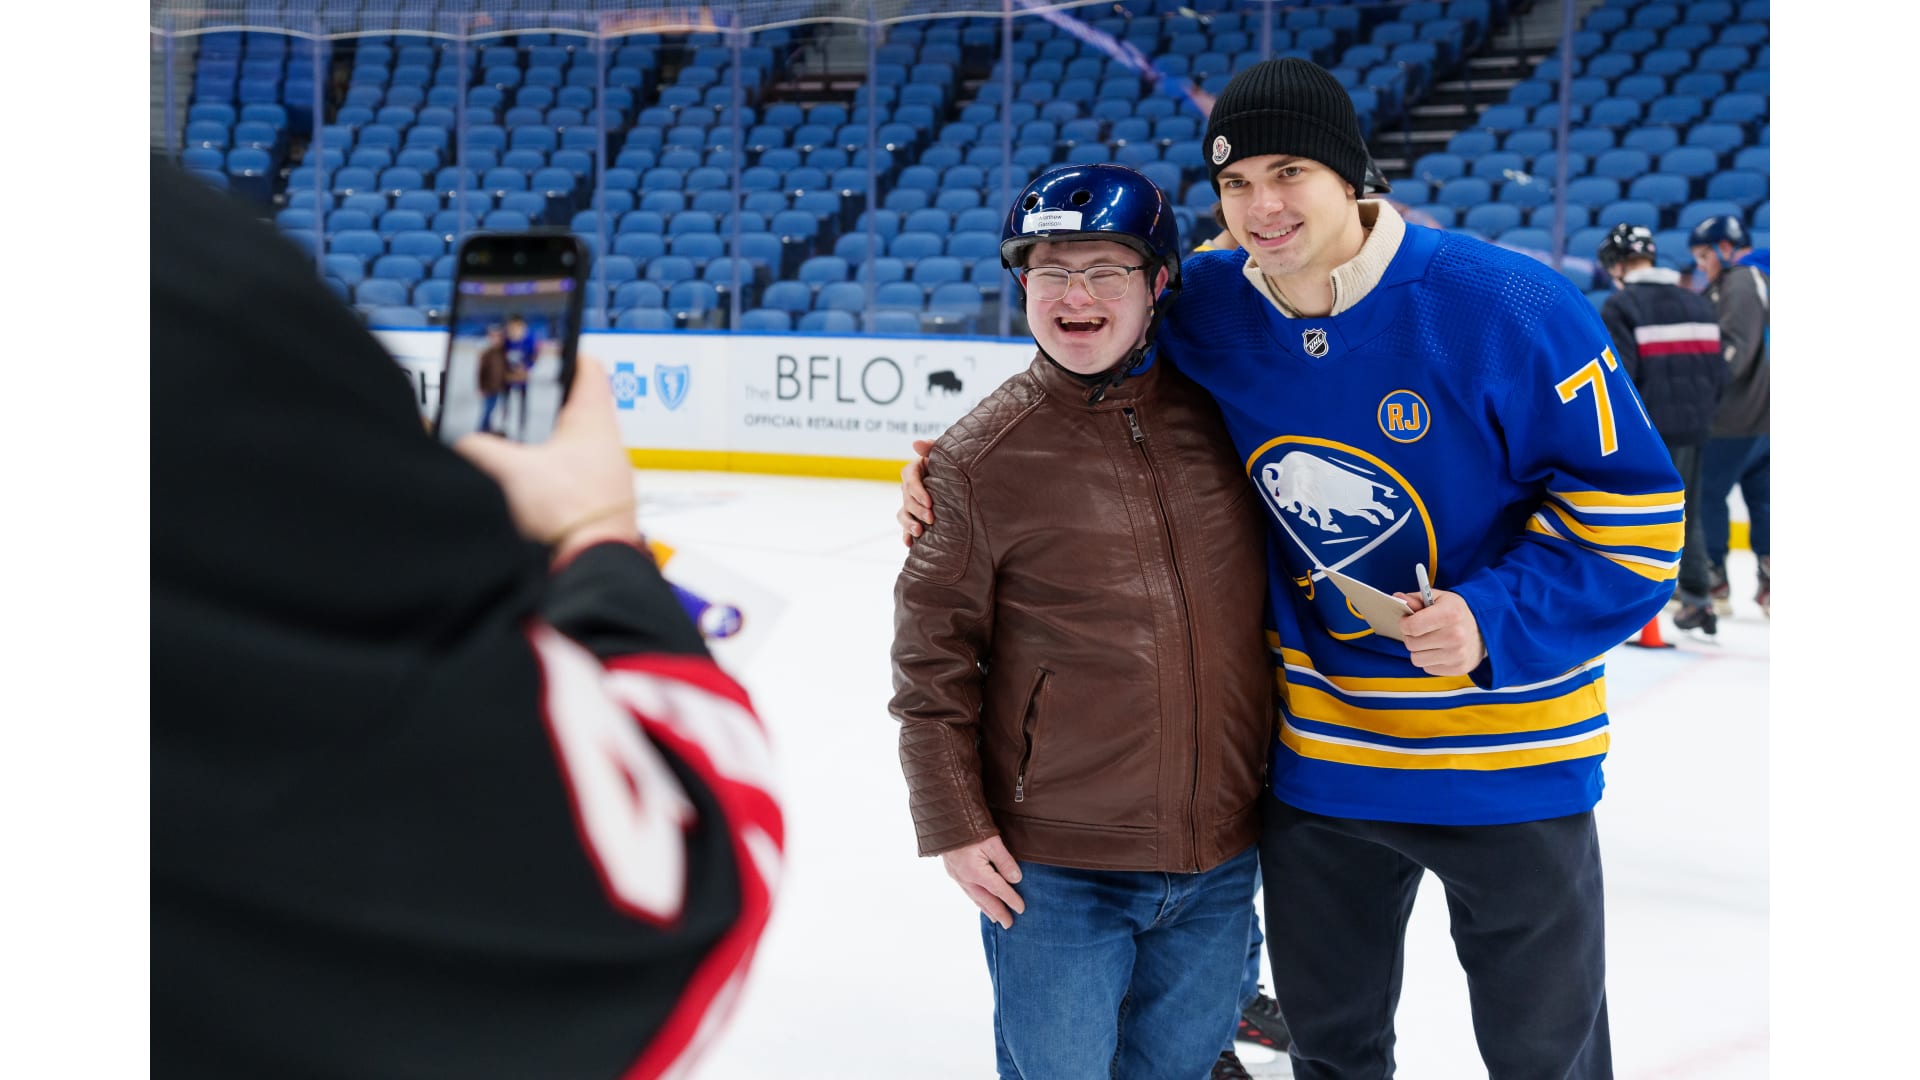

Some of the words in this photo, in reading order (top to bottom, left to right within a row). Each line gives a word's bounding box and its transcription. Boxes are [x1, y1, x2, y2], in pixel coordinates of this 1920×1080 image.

[1308, 335, 1322, 352] NHL
[744, 384, 770, 401] The
[776, 355, 904, 405] BFLO
[1554, 344, 1652, 457] 7
[744, 413, 801, 428] OFFICIAL
[807, 416, 860, 431] RETAILER
[864, 418, 883, 432] OF
[886, 420, 908, 434] THE
[913, 422, 947, 436] BUFF
[1387, 402, 1421, 431] RJ
